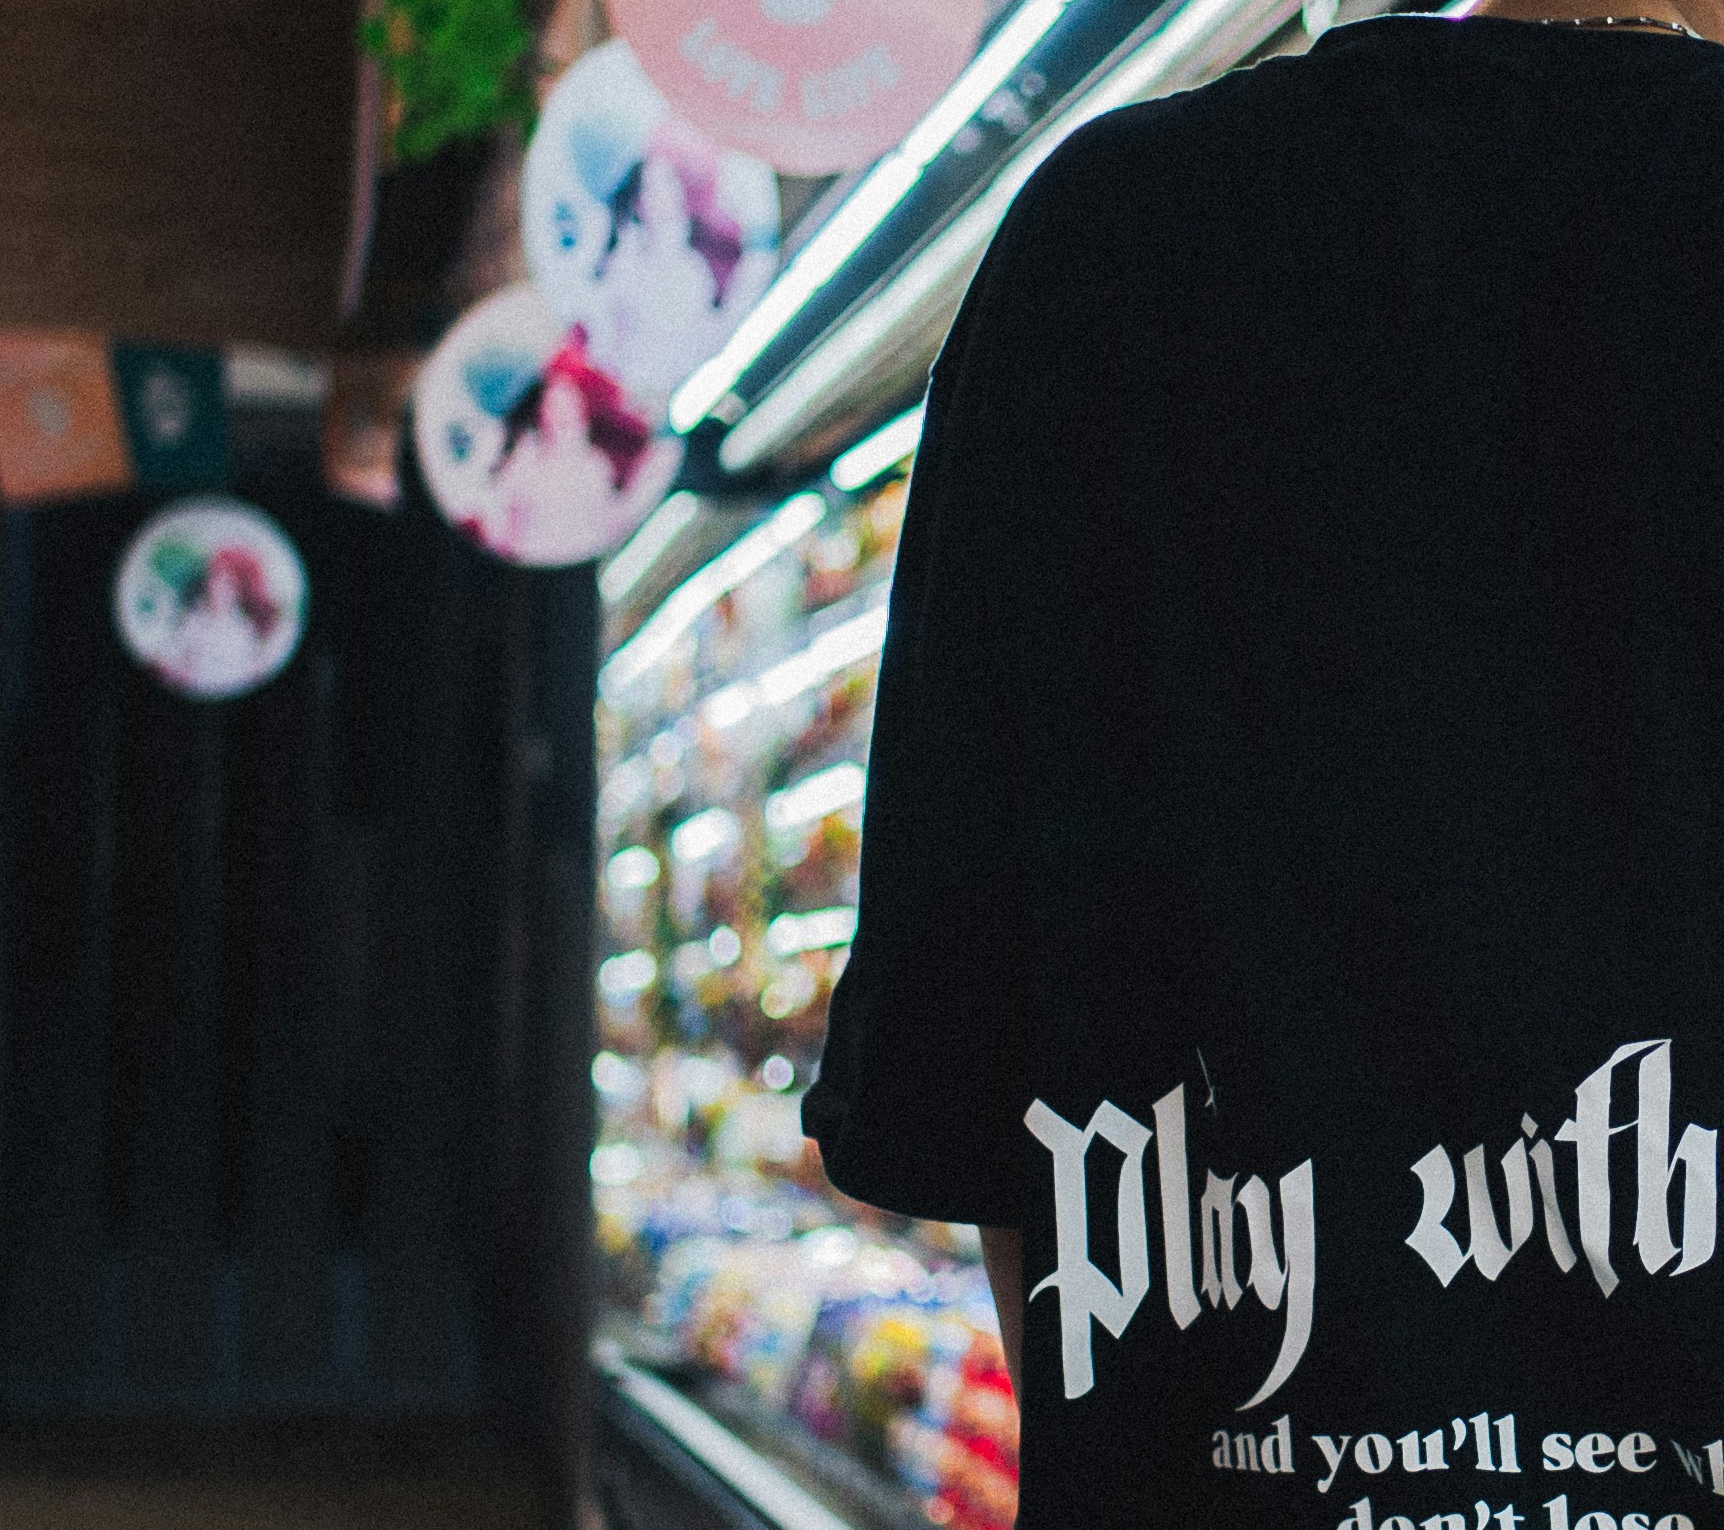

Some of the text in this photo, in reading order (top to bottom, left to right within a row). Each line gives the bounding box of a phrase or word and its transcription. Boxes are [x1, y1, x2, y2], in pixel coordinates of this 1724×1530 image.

[1404, 1038, 1719, 1299] with
[1212, 1413, 1295, 1474] and
[1311, 1411, 1522, 1494] you'll
[1541, 1431, 1657, 1474] see
